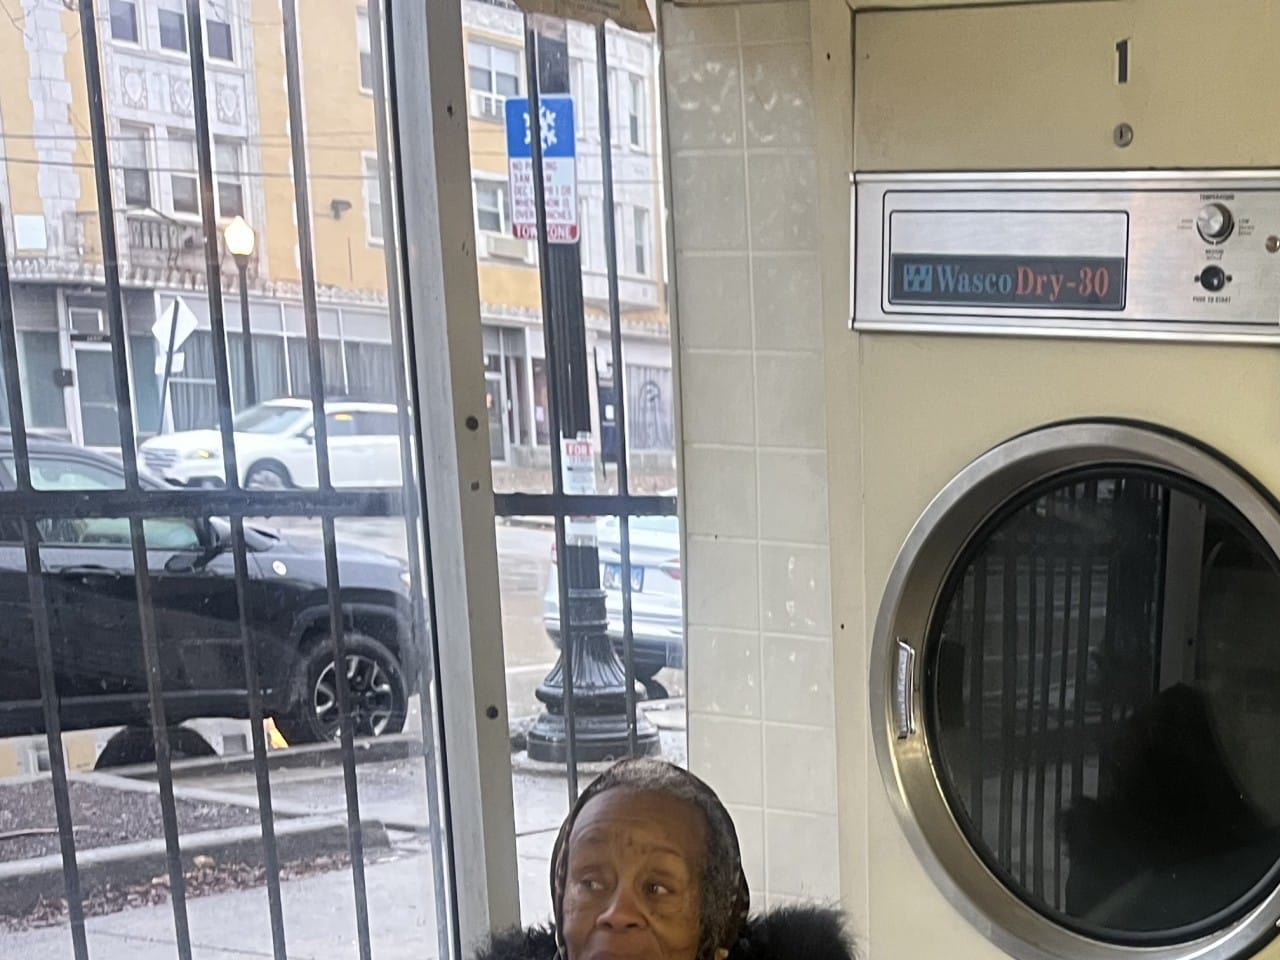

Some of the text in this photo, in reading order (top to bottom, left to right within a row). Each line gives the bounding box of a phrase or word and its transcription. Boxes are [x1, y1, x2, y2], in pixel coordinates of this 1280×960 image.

[1115, 38, 1129, 84] 1
[936, 264, 1109, 301] Wasco Dry-30
